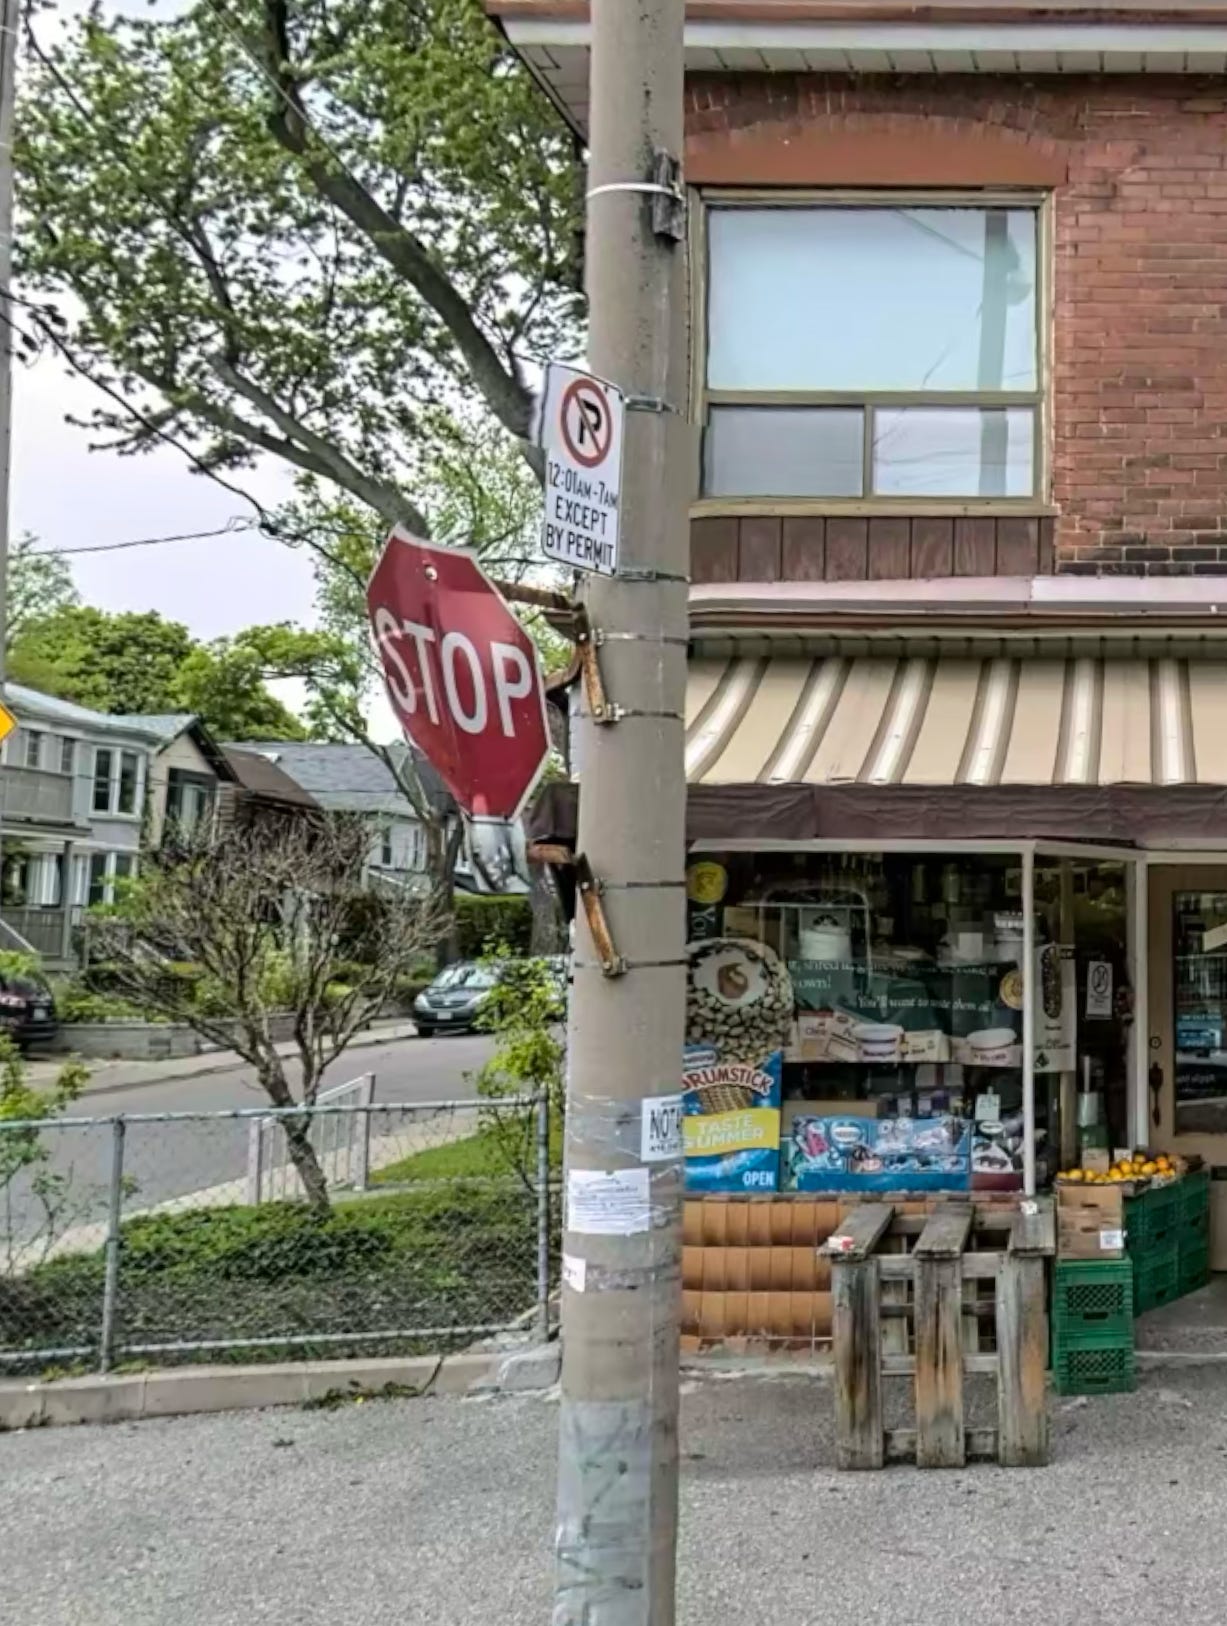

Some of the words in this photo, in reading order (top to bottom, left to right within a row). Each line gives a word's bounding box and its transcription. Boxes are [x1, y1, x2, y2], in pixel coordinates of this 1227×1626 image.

[555, 495, 608, 536] EXCEPT
[546, 523, 565, 551] BY
[567, 531, 614, 567] PERMIT
[374, 607, 532, 738] STOP
[696, 1114, 753, 1136] TASTE
[742, 1170, 775, 1187] OPEN
